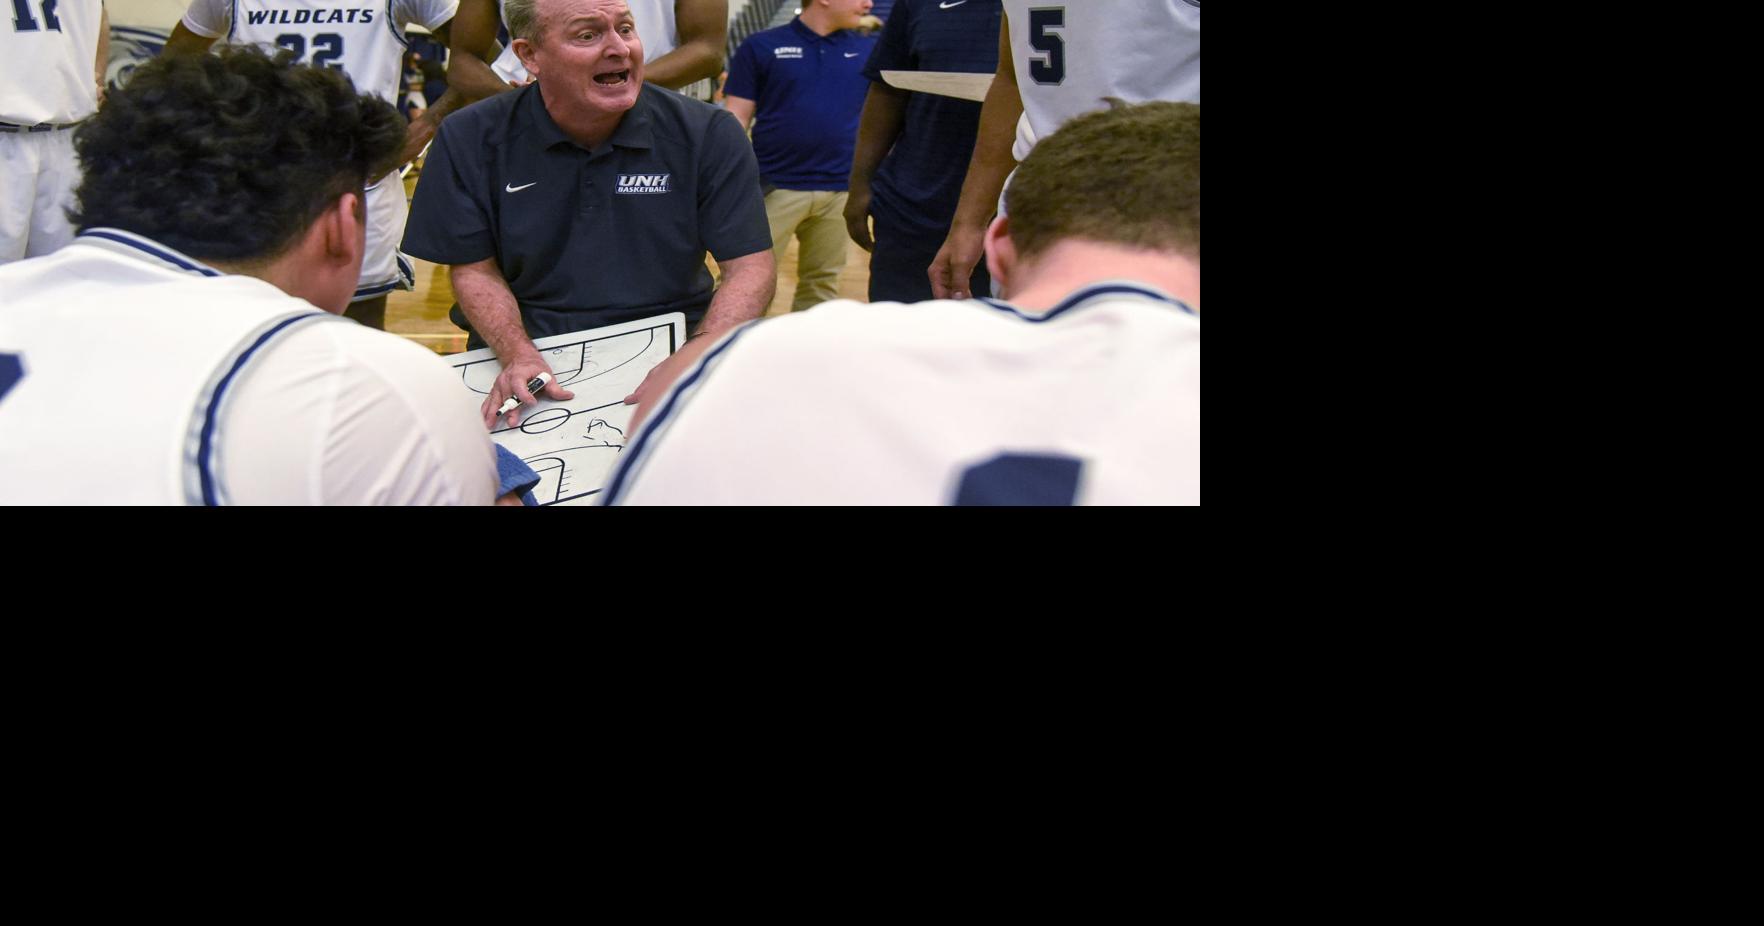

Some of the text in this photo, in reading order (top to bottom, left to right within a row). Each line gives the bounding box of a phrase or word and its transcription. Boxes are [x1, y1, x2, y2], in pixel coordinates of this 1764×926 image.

[247, 8, 374, 25] WILDCATS
[1028, 6, 1066, 86] 5
[618, 174, 670, 187] UNH
